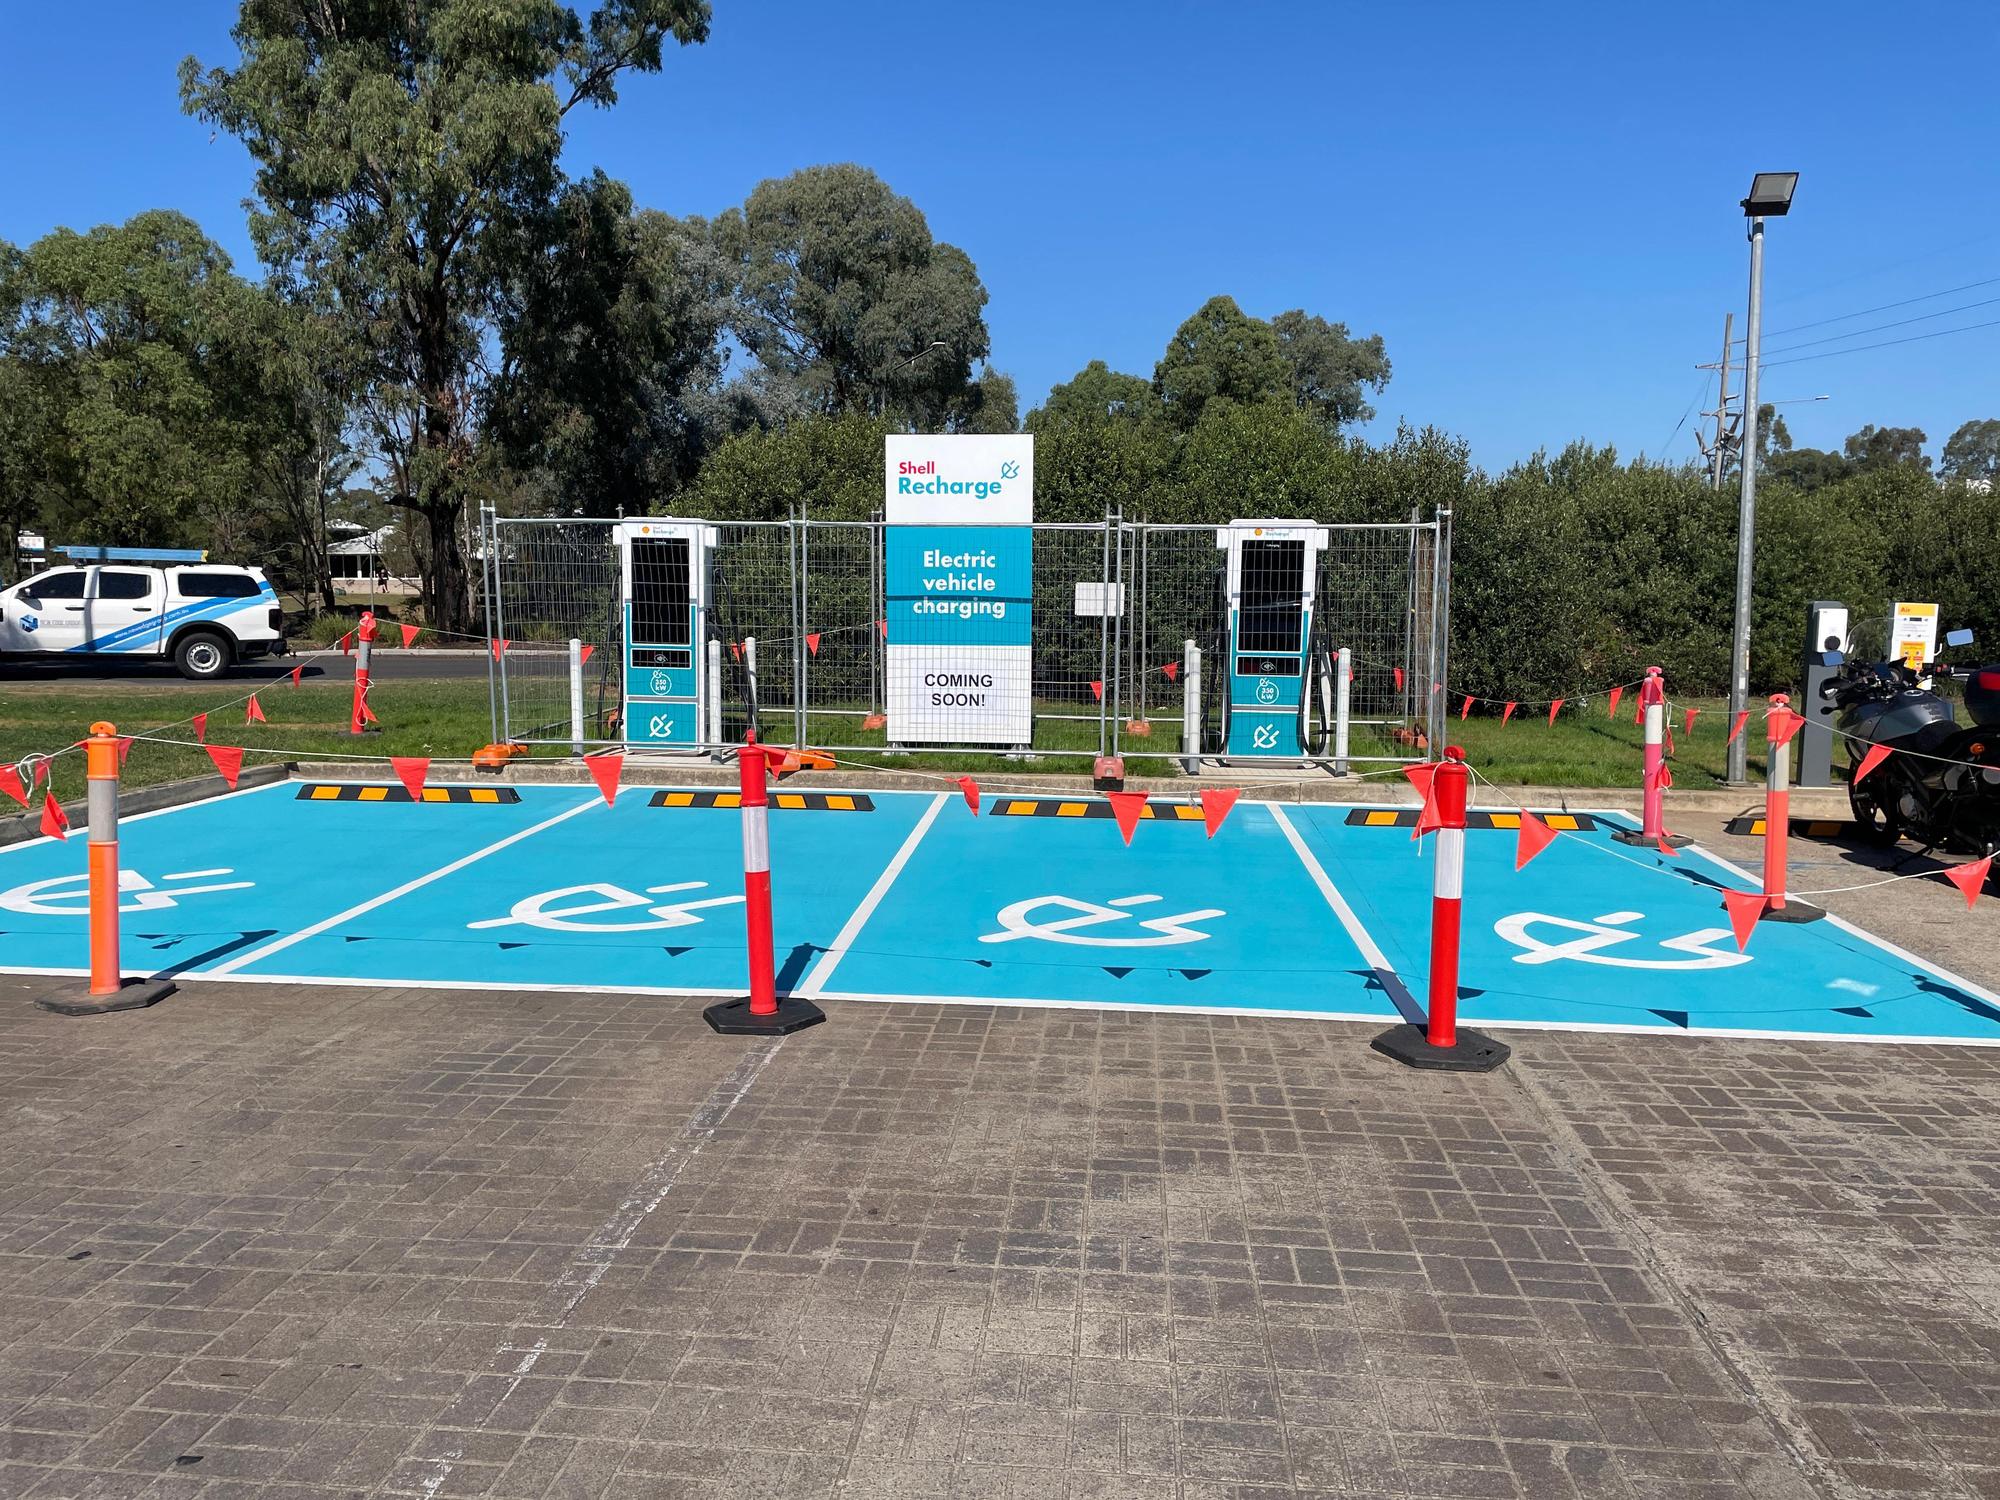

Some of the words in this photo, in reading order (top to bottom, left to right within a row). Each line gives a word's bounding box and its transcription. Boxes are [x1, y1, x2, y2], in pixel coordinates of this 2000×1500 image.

[899, 461, 935, 475] Shell
[898, 475, 1002, 499] Recharge
[923, 549, 996, 568] Electric
[922, 573, 996, 591] vehicle
[912, 597, 1006, 618] charging
[924, 673, 993, 688] COMING
[931, 693, 985, 707] SOON!
